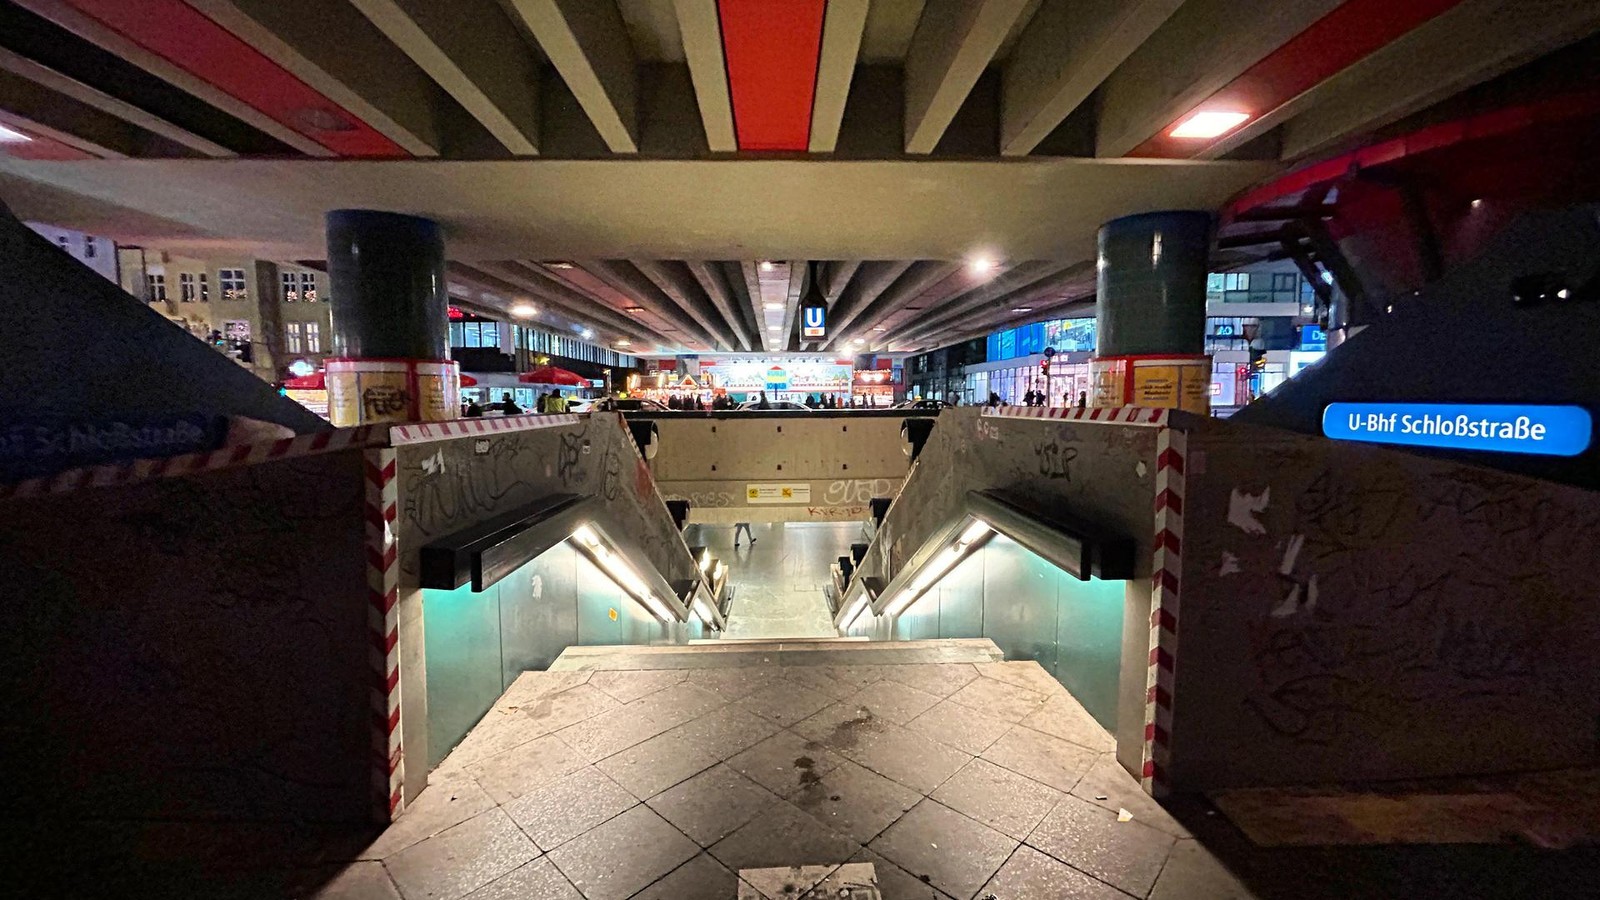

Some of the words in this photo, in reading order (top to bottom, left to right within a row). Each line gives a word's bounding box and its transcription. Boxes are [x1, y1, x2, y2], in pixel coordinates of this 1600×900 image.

[806, 307, 823, 327] U
[1348, 413, 1398, 433] U-Bhf
[1401, 414, 1546, 441] Schloßstraße
